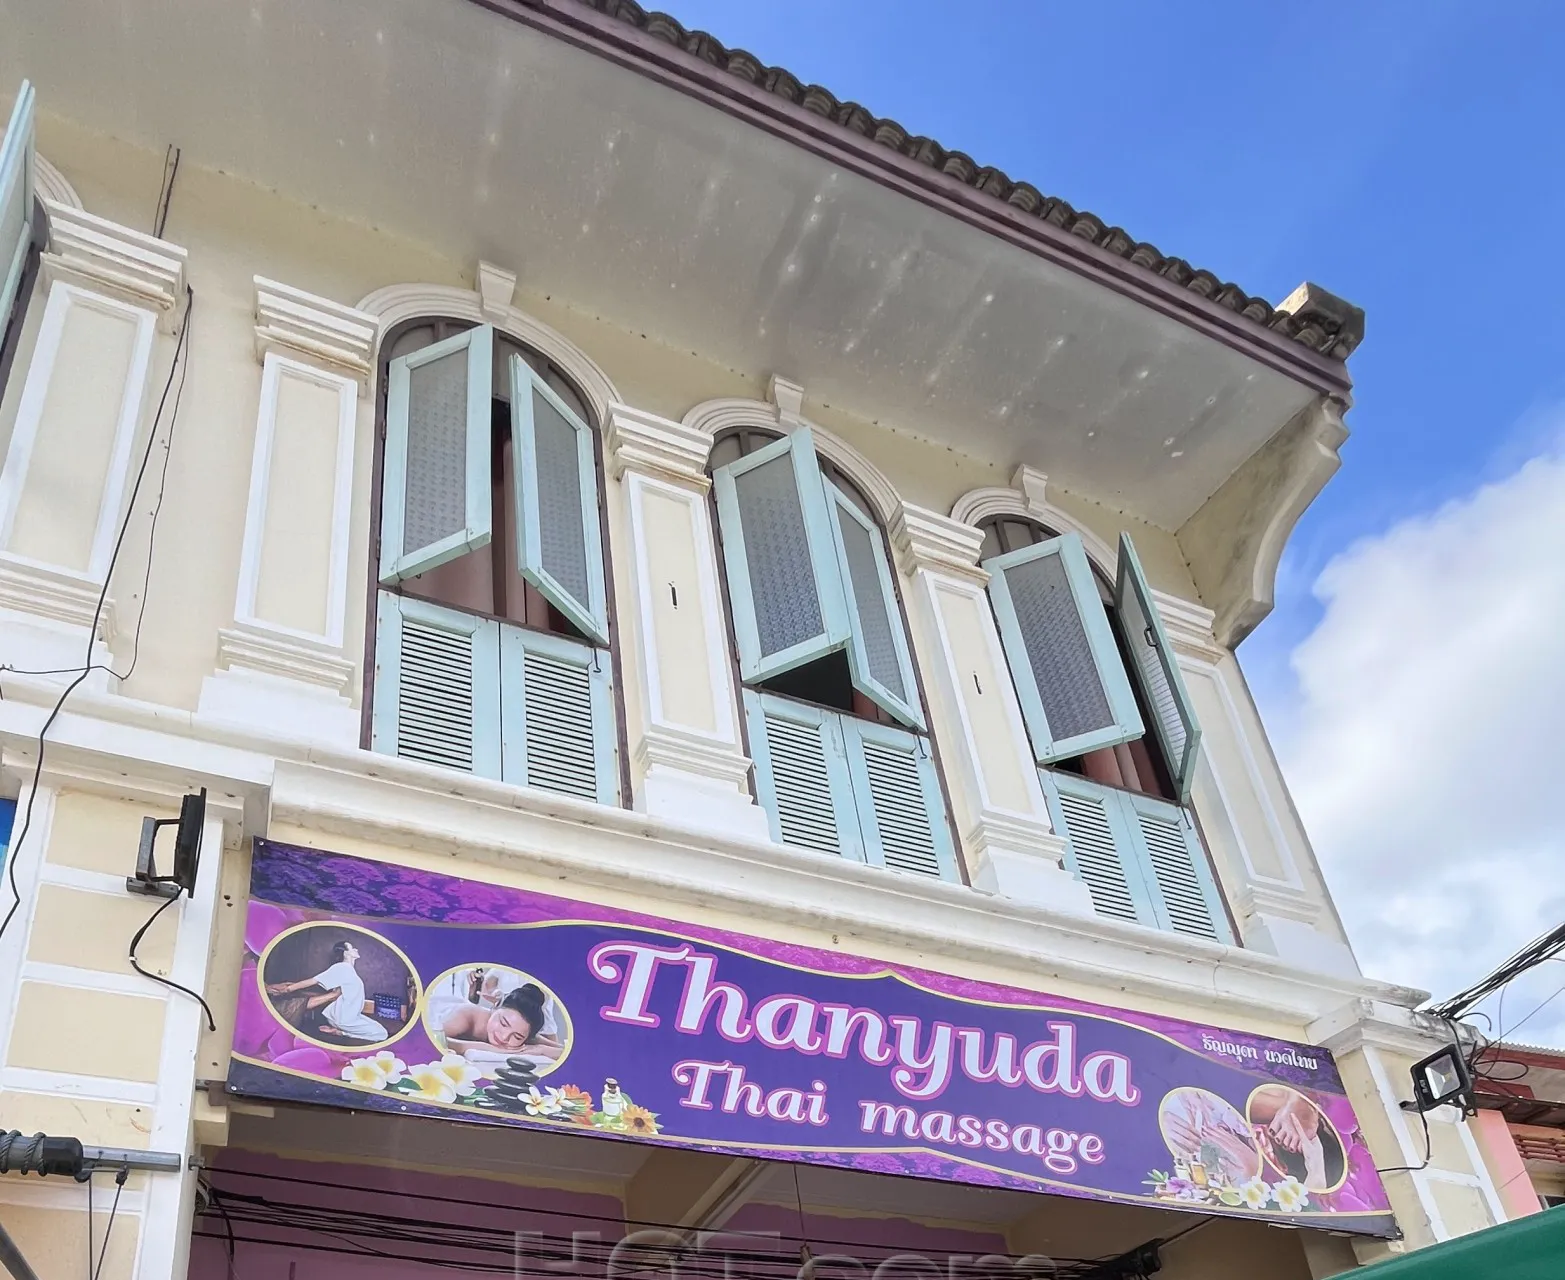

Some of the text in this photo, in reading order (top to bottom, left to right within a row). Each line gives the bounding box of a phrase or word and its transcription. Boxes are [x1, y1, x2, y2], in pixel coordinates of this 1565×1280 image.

[590, 942, 1139, 1104] Thanyuda
[674, 1061, 1106, 1173] Thai massage
